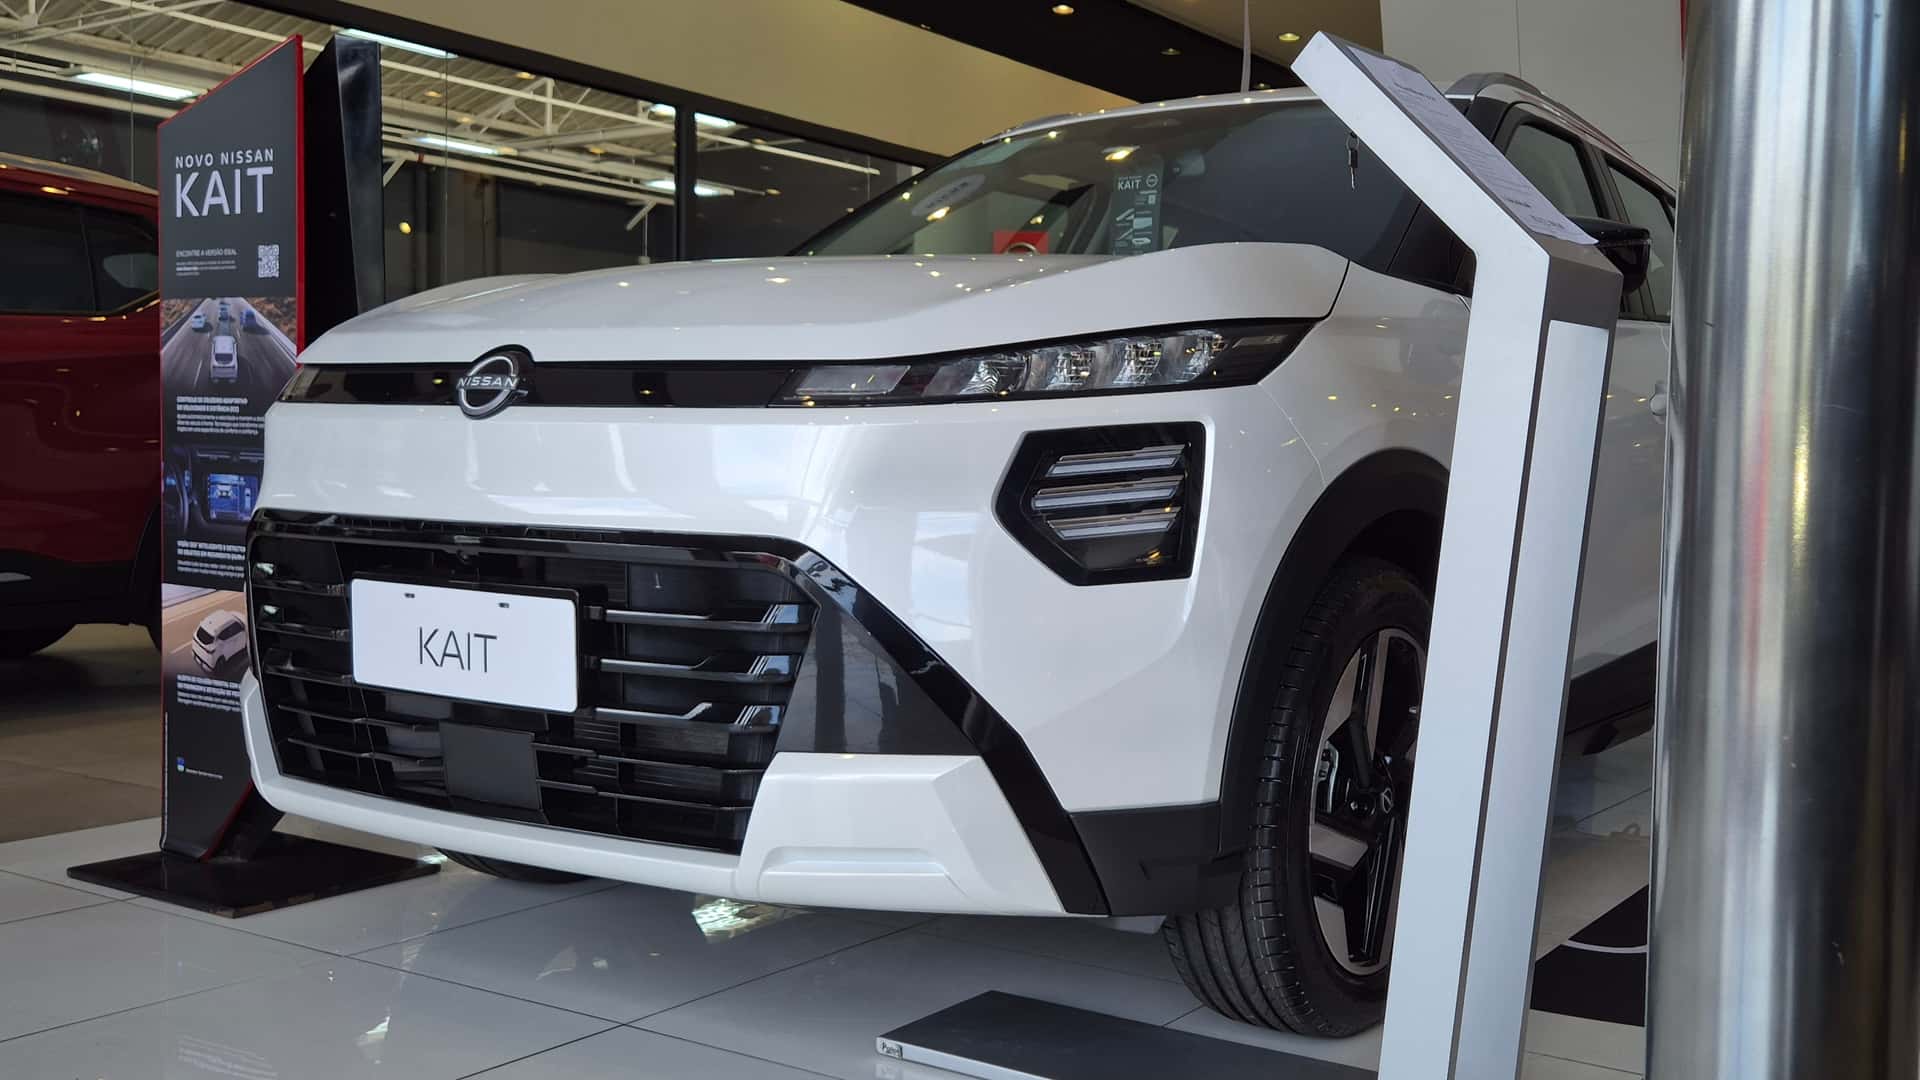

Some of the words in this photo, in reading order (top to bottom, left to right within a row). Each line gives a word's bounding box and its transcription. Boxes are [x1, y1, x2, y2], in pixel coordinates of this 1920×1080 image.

[175, 153, 214, 169] NOVO
[220, 148, 274, 165] NISSAN
[175, 166, 274, 218] KAIT
[1118, 180, 1141, 191] KAIT
[457, 376, 518, 387] NISSAN
[419, 626, 498, 673] KAIT
